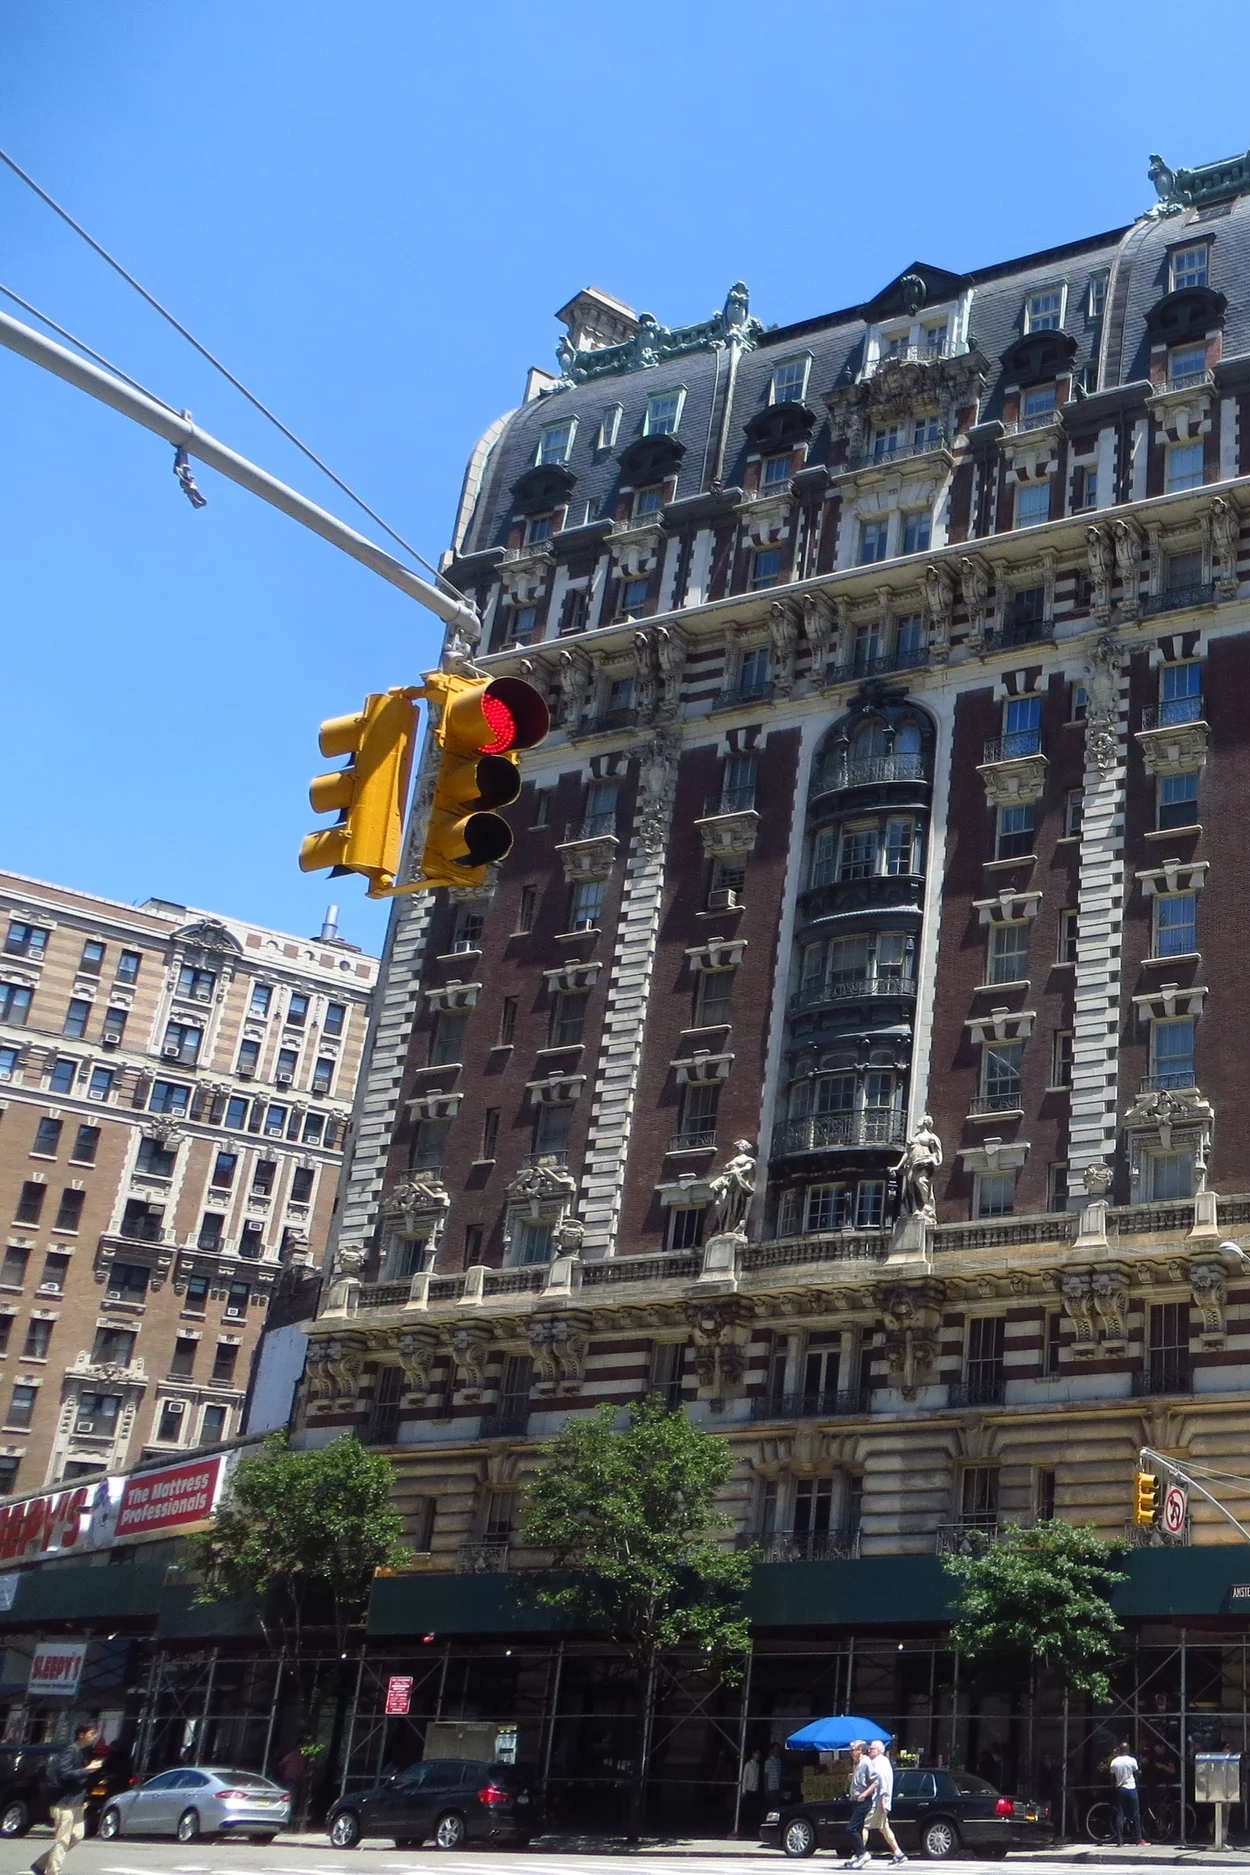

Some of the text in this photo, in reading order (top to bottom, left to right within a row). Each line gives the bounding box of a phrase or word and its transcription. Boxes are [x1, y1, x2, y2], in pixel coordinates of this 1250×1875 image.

[128, 1473, 210, 1506] The Mattress
[121, 1492, 208, 1526] Professionals
